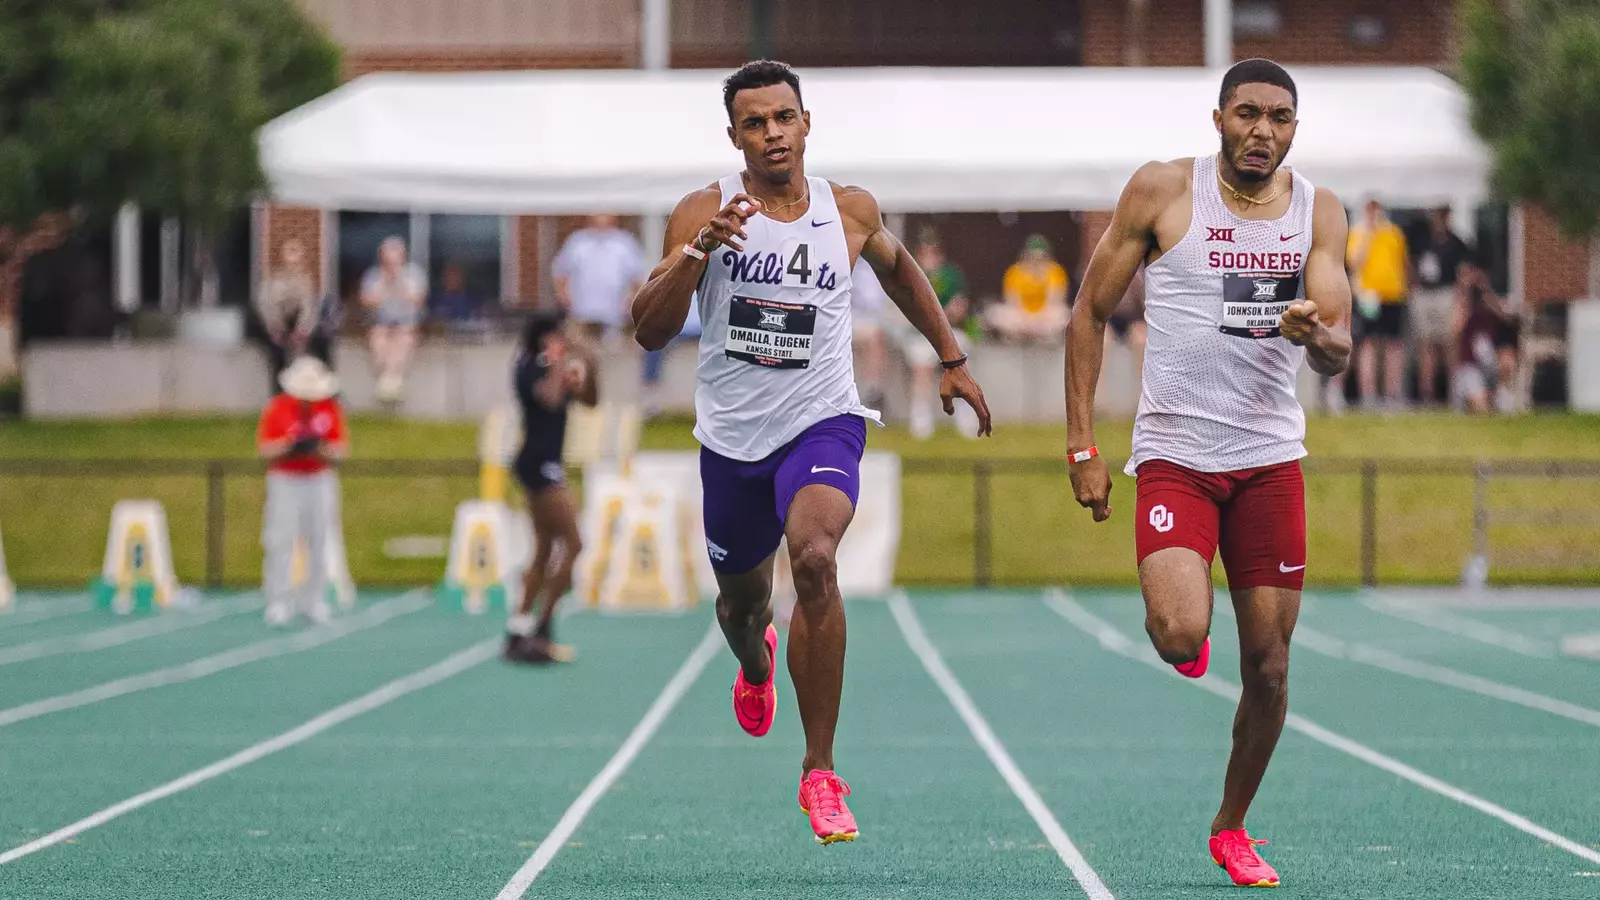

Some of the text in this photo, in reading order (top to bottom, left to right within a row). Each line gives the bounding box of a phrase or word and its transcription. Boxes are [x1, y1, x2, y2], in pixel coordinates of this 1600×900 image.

[1205, 226, 1236, 244] XII
[786, 243, 812, 285] 4
[1208, 250, 1302, 270] SOONERS
[722, 250, 836, 291] Wildts
[1264, 304, 1291, 316] RICHAR
[1246, 319, 1276, 327] OKLAHOMA
[730, 329, 811, 349] OMALLA, EUGENE
[745, 344, 793, 358] KANSAS STATE
[1149, 504, 1174, 533] OU
